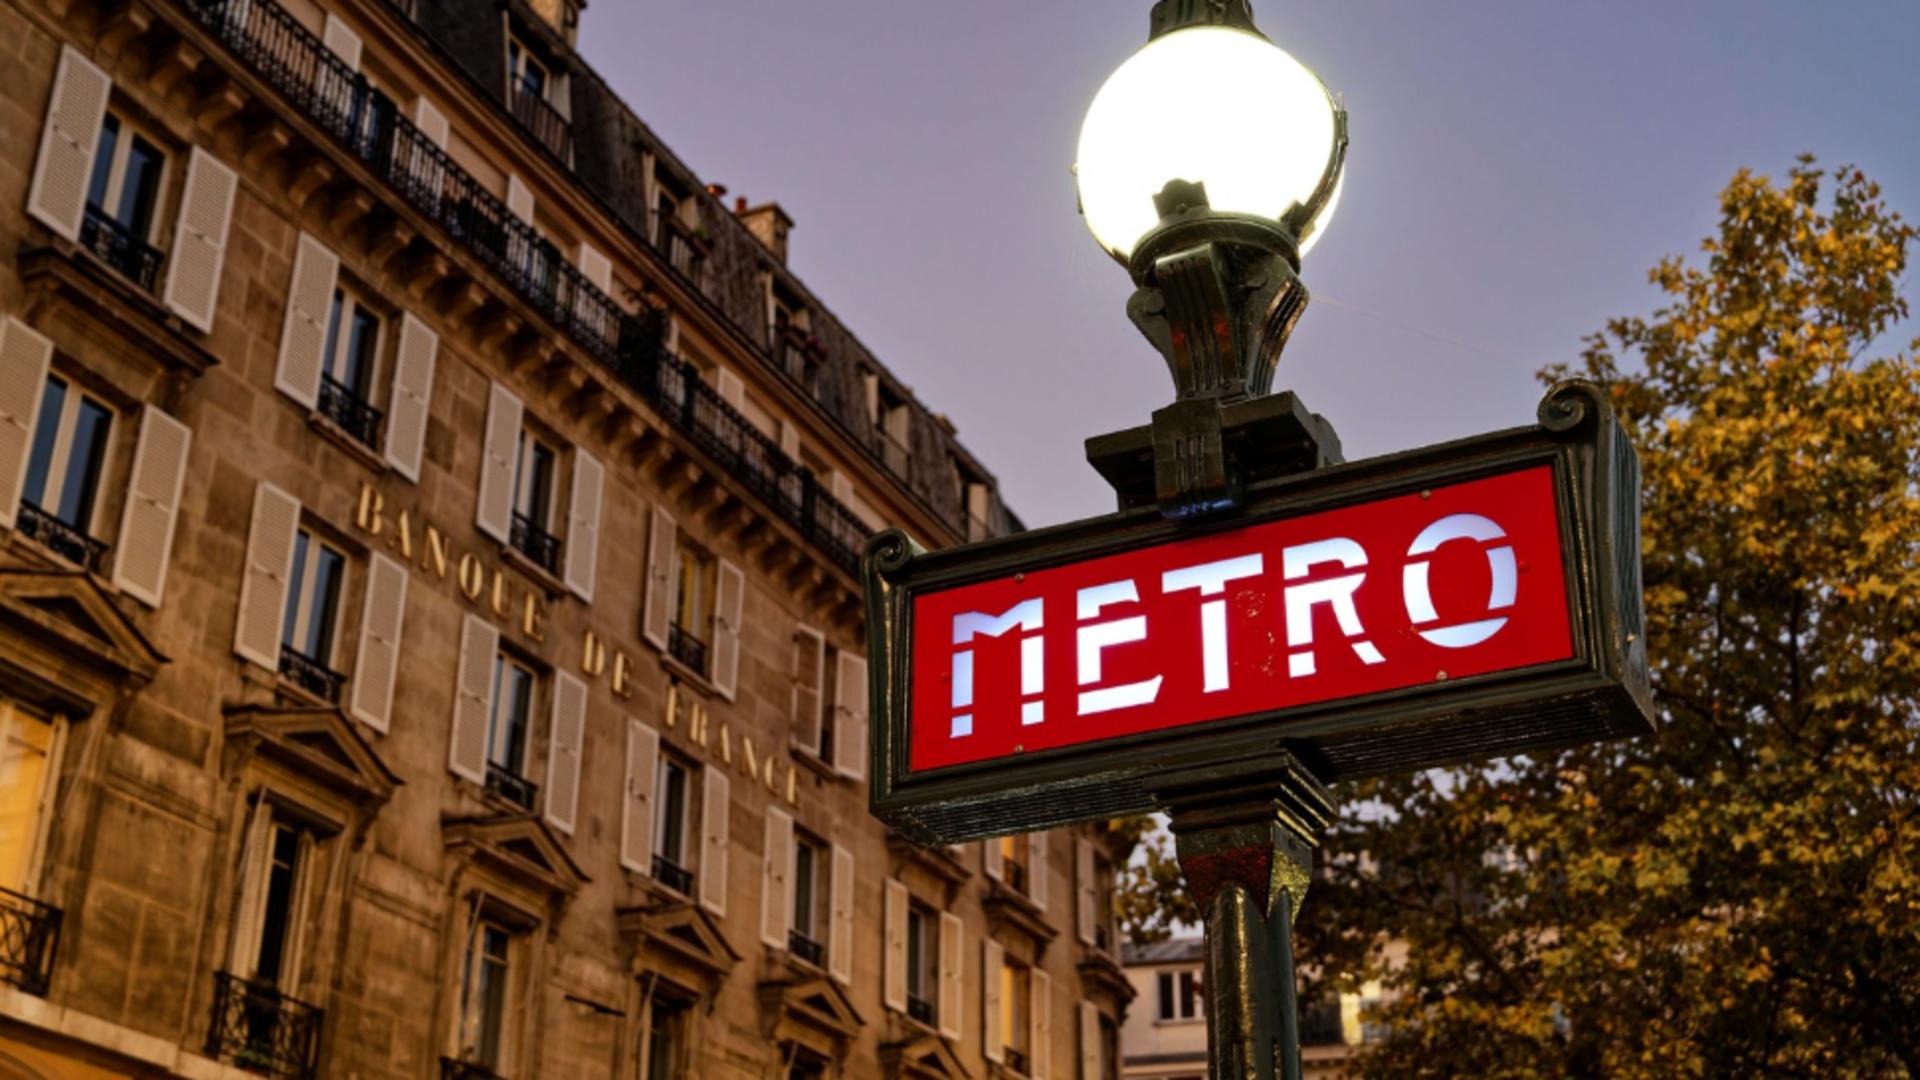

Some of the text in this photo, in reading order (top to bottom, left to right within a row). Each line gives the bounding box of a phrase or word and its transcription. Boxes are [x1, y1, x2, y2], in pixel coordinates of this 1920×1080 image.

[357, 483, 800, 805] BANQUE DE FRANCE
[950, 513, 1517, 738] METRO
